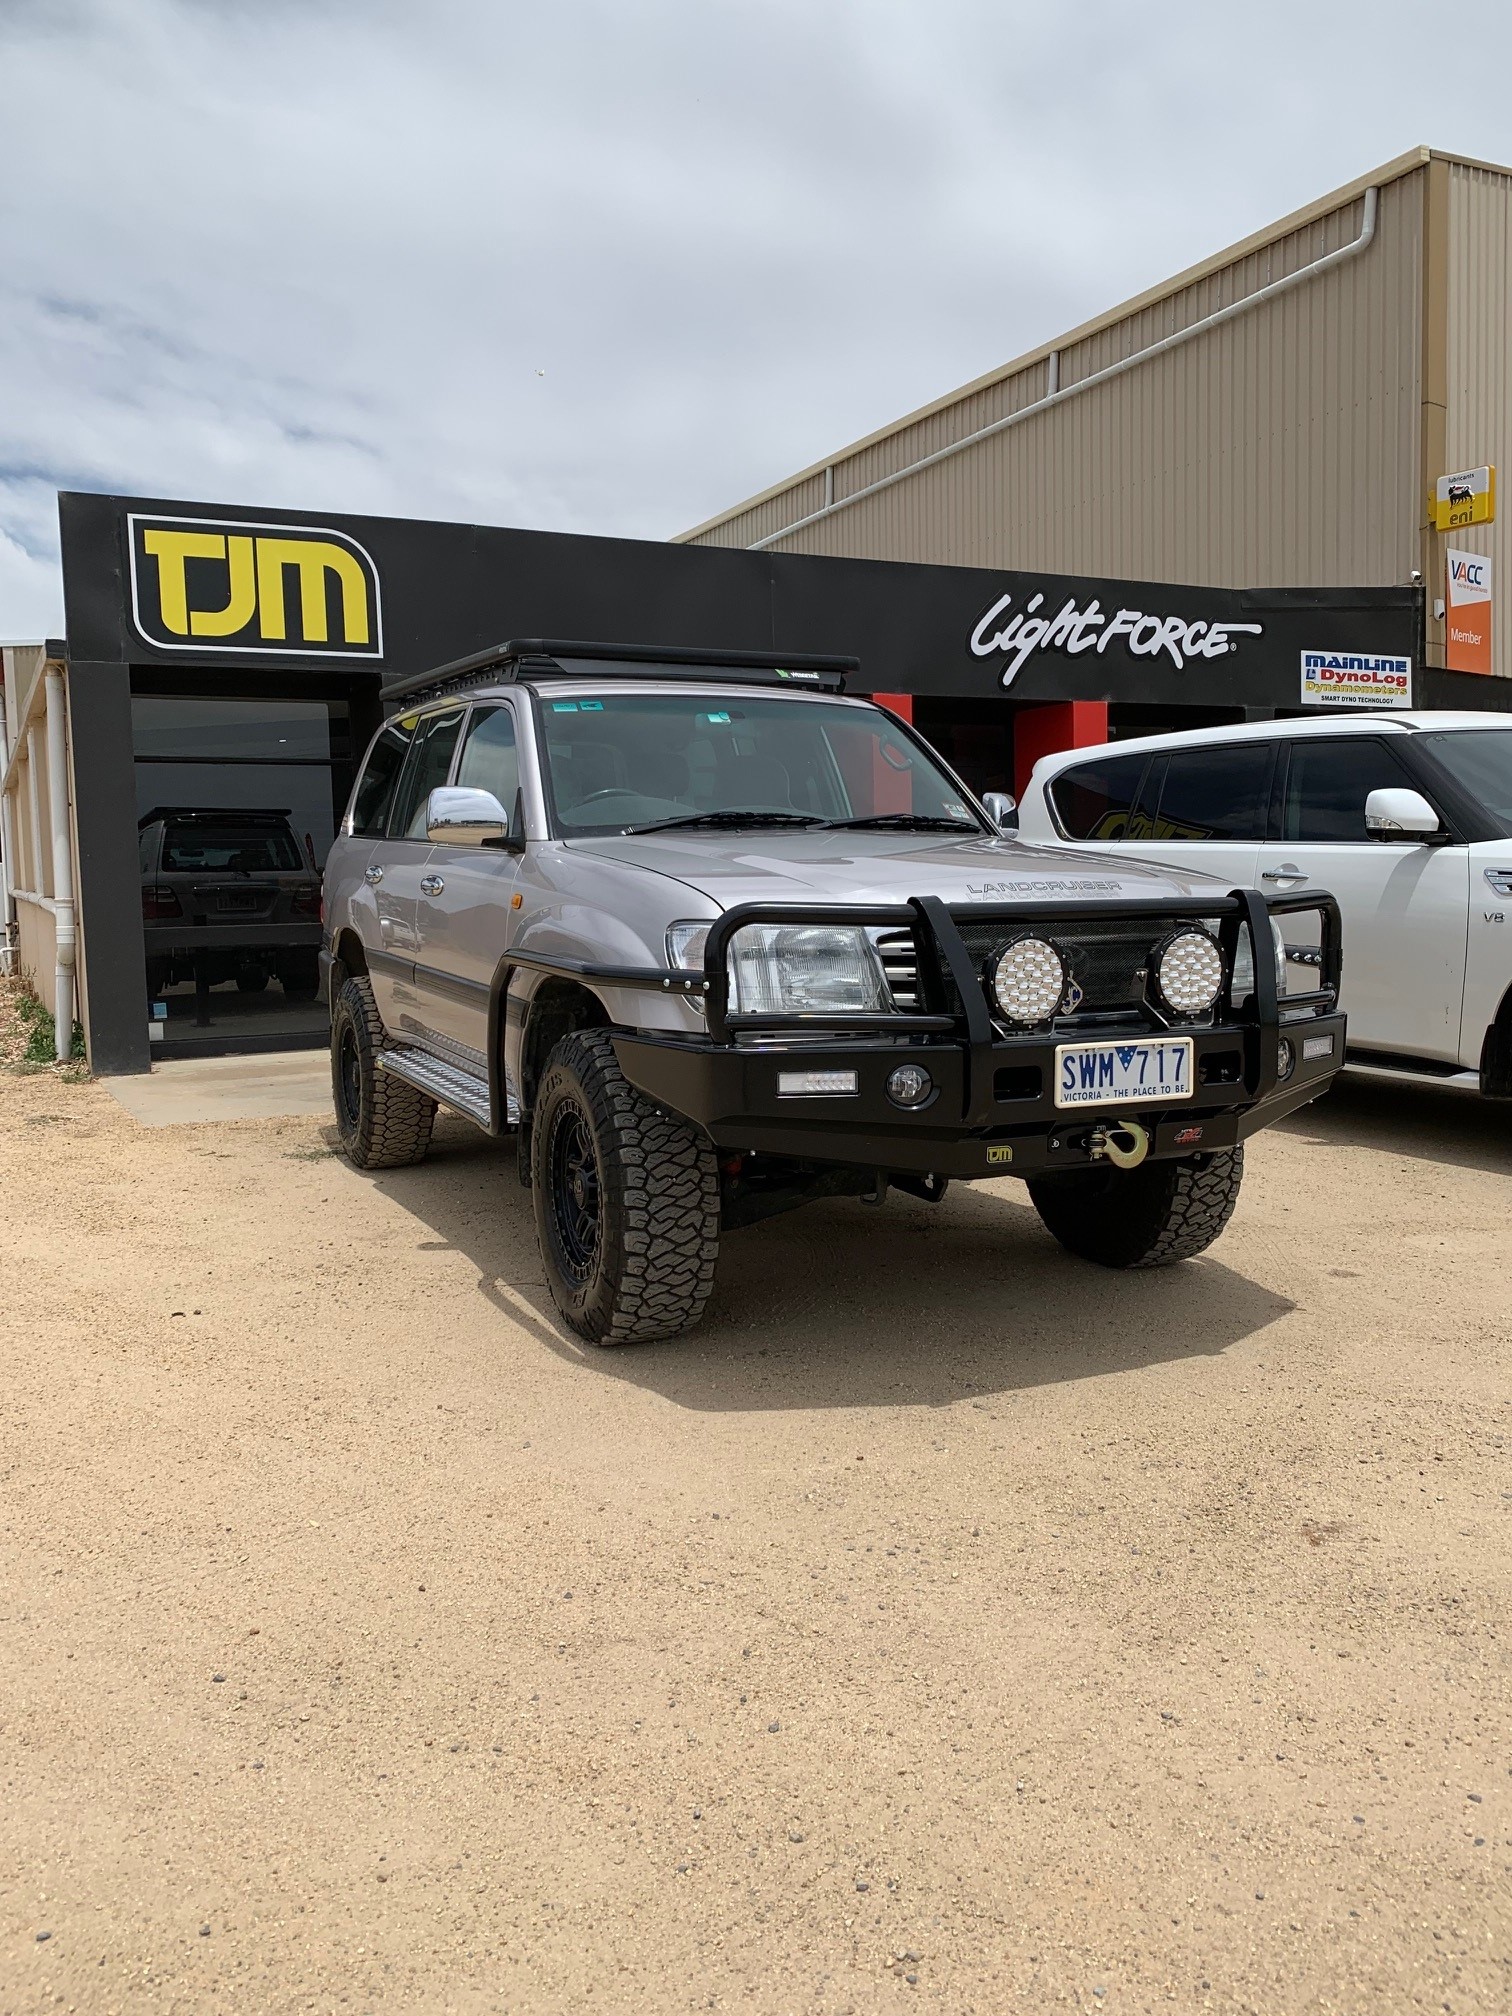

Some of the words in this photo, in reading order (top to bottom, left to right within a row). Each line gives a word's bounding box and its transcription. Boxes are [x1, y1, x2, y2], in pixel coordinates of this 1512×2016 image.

[1448, 473, 1475, 483] lubricants
[1449, 505, 1473, 525] eni
[1451, 559, 1483, 586] VACC
[144, 529, 369, 644] TJM
[1450, 627, 1482, 645] Member
[1320, 668, 1408, 687] DynoLog
[1305, 680, 1408, 695] Dynamometers
[966, 880, 1123, 894] LANDCRUISER
[1483, 911, 1505, 923] V8
[1062, 1052, 1114, 1090] SWM
[1137, 1047, 1185, 1084] 717
[1063, 1091, 1102, 1102] VICTORIA
[1114, 1088, 1129, 1098] THE
[1132, 1086, 1157, 1096] PLACE
[1161, 1085, 1171, 1094] TO
[988, 1147, 1011, 1161] TJM
